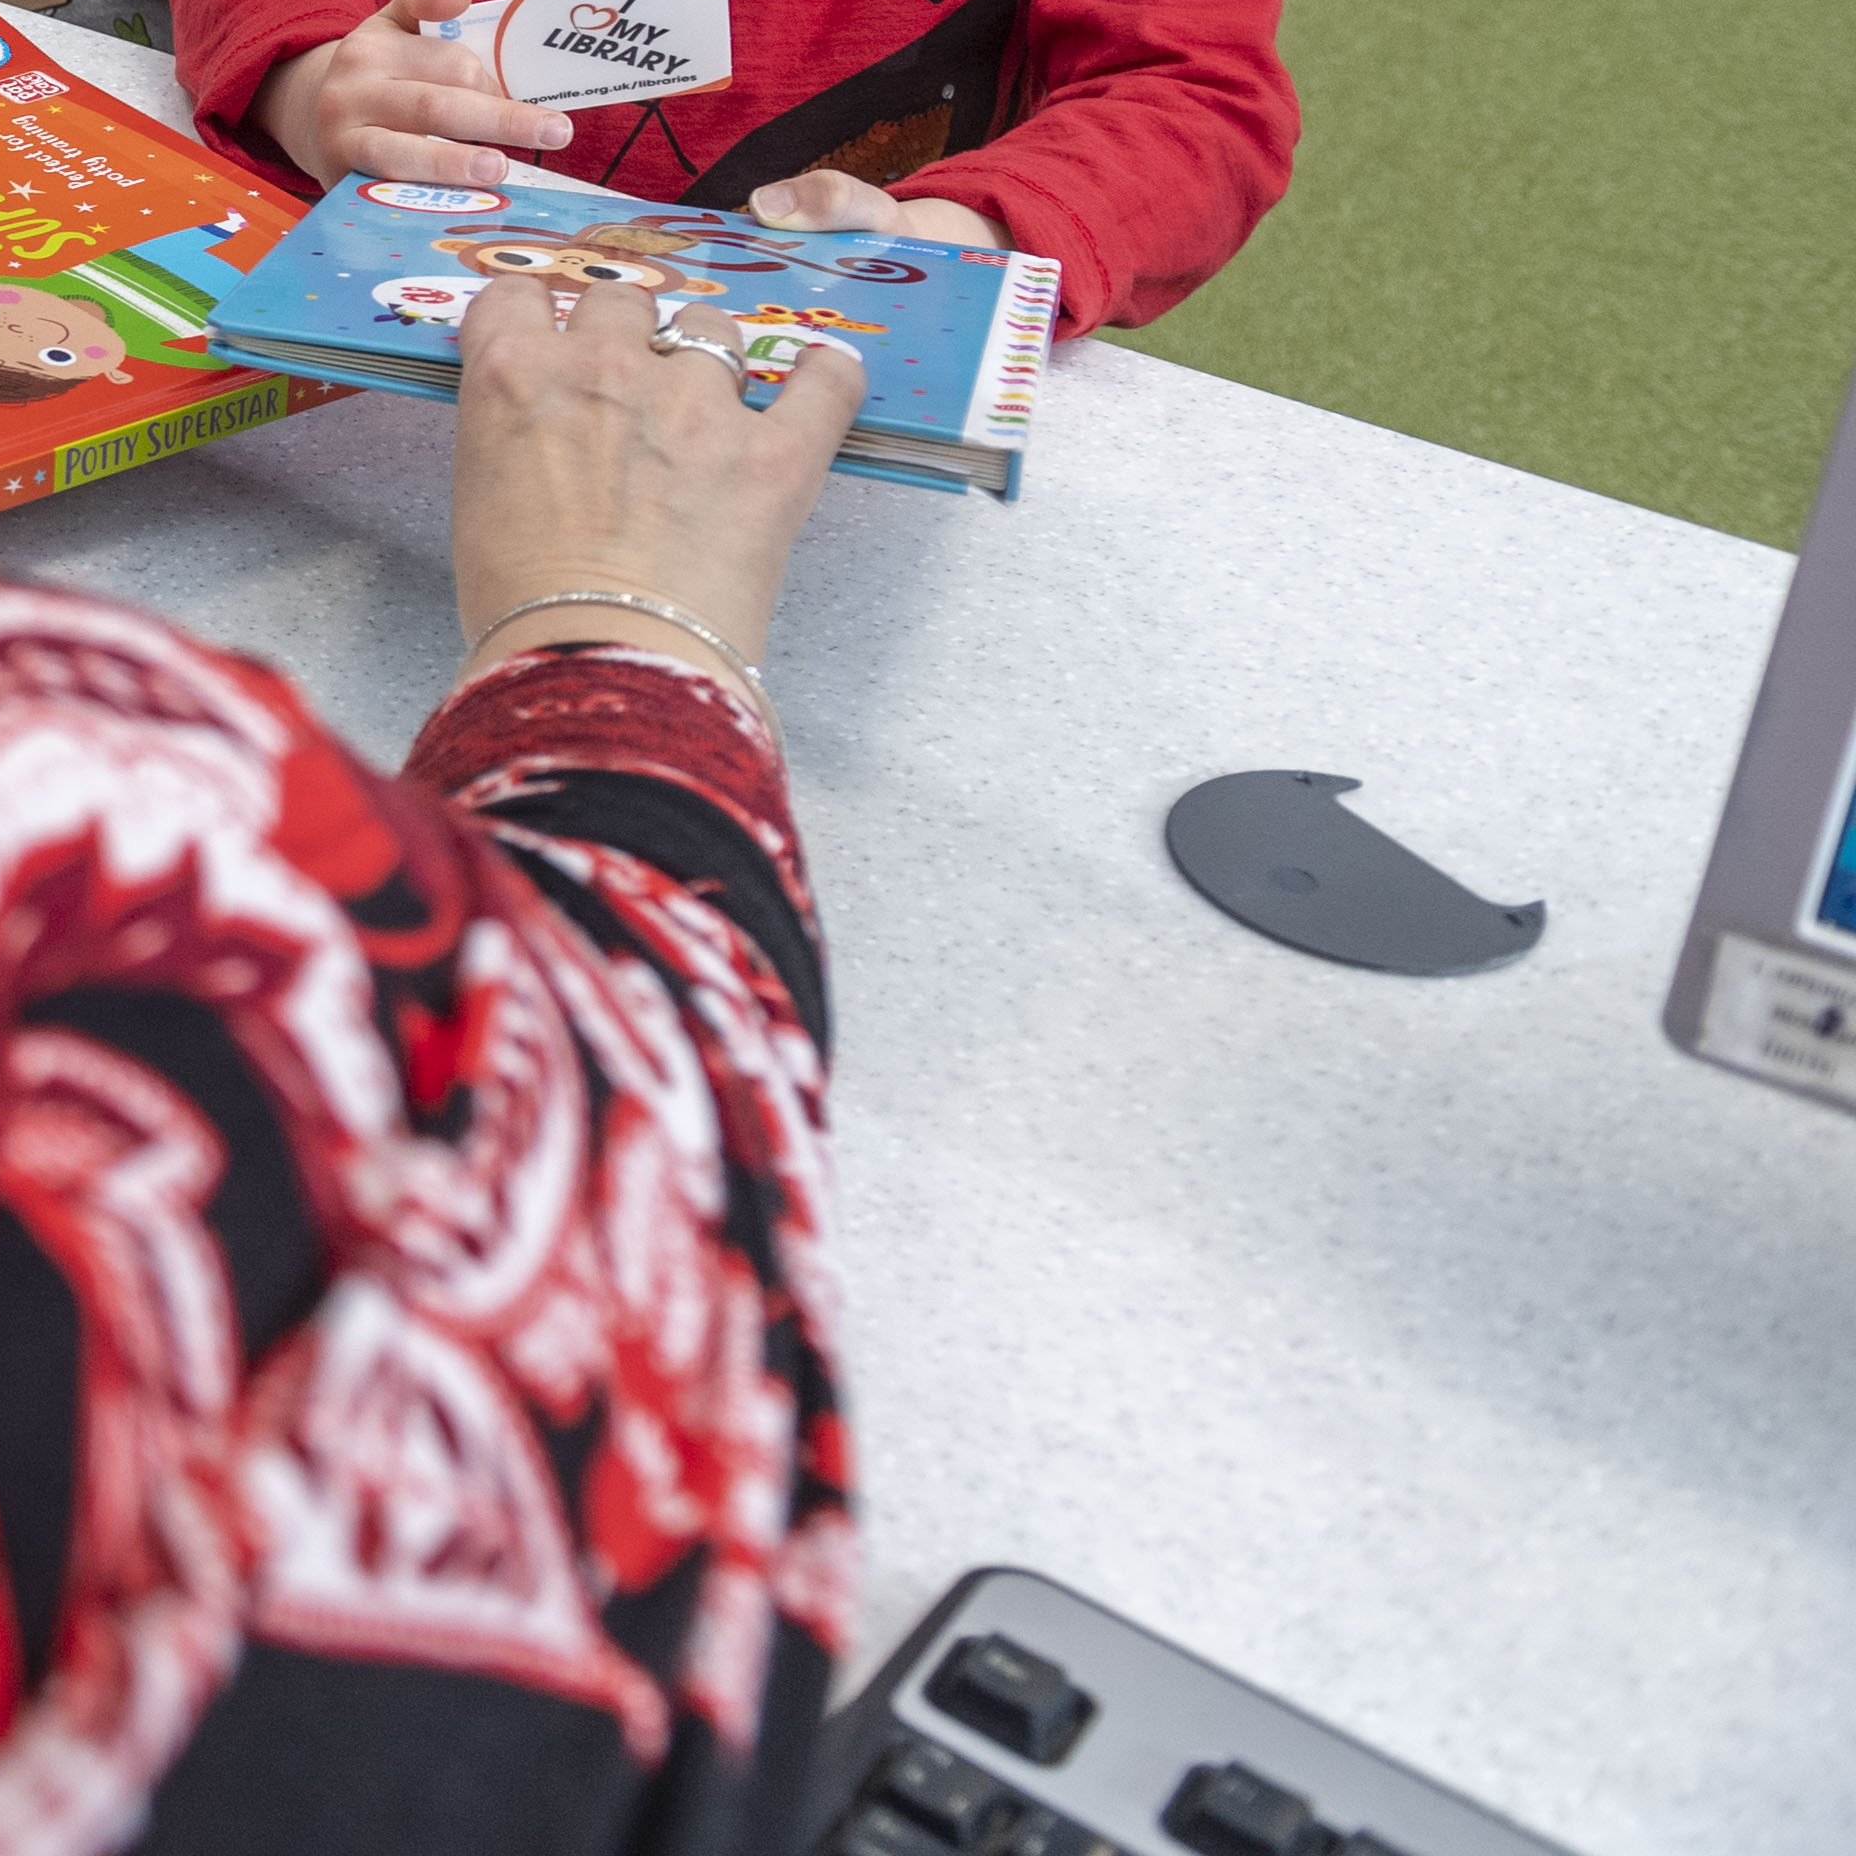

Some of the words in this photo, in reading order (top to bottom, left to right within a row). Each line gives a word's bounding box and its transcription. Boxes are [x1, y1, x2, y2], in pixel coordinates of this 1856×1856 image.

[606, 18, 670, 46] MY
[542, 27, 690, 76] LIBRARY
[519, 73, 697, 106] sgowlife.org.uk/libraries
[11, 115, 83, 159] training
[24, 150, 94, 189] Perfect
[81, 156, 146, 188] potty
[397, 188, 472, 205] BIG
[64, 431, 138, 485] POTTY
[146, 387, 279, 457] SUPERSTAR
